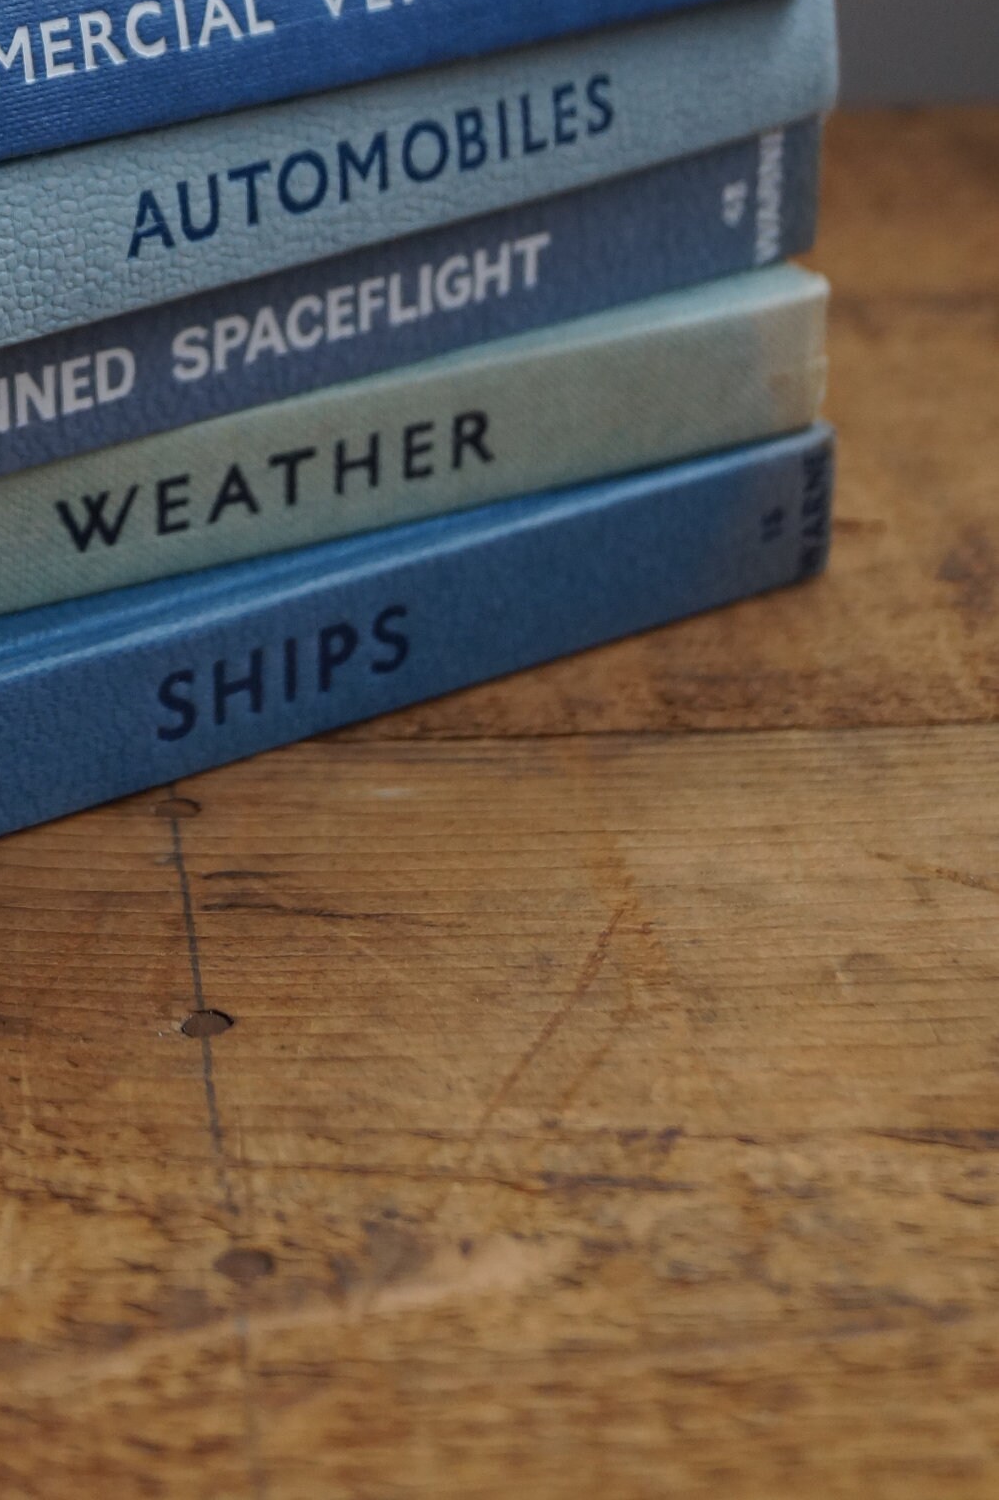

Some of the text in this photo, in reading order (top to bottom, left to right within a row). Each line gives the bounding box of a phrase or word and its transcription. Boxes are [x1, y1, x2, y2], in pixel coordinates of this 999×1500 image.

[127, 74, 615, 259] AUTOMOBILES
[170, 232, 552, 383] SPACEFLIGHT
[54, 410, 496, 553] WEATHER
[155, 605, 411, 742] SHIPS
